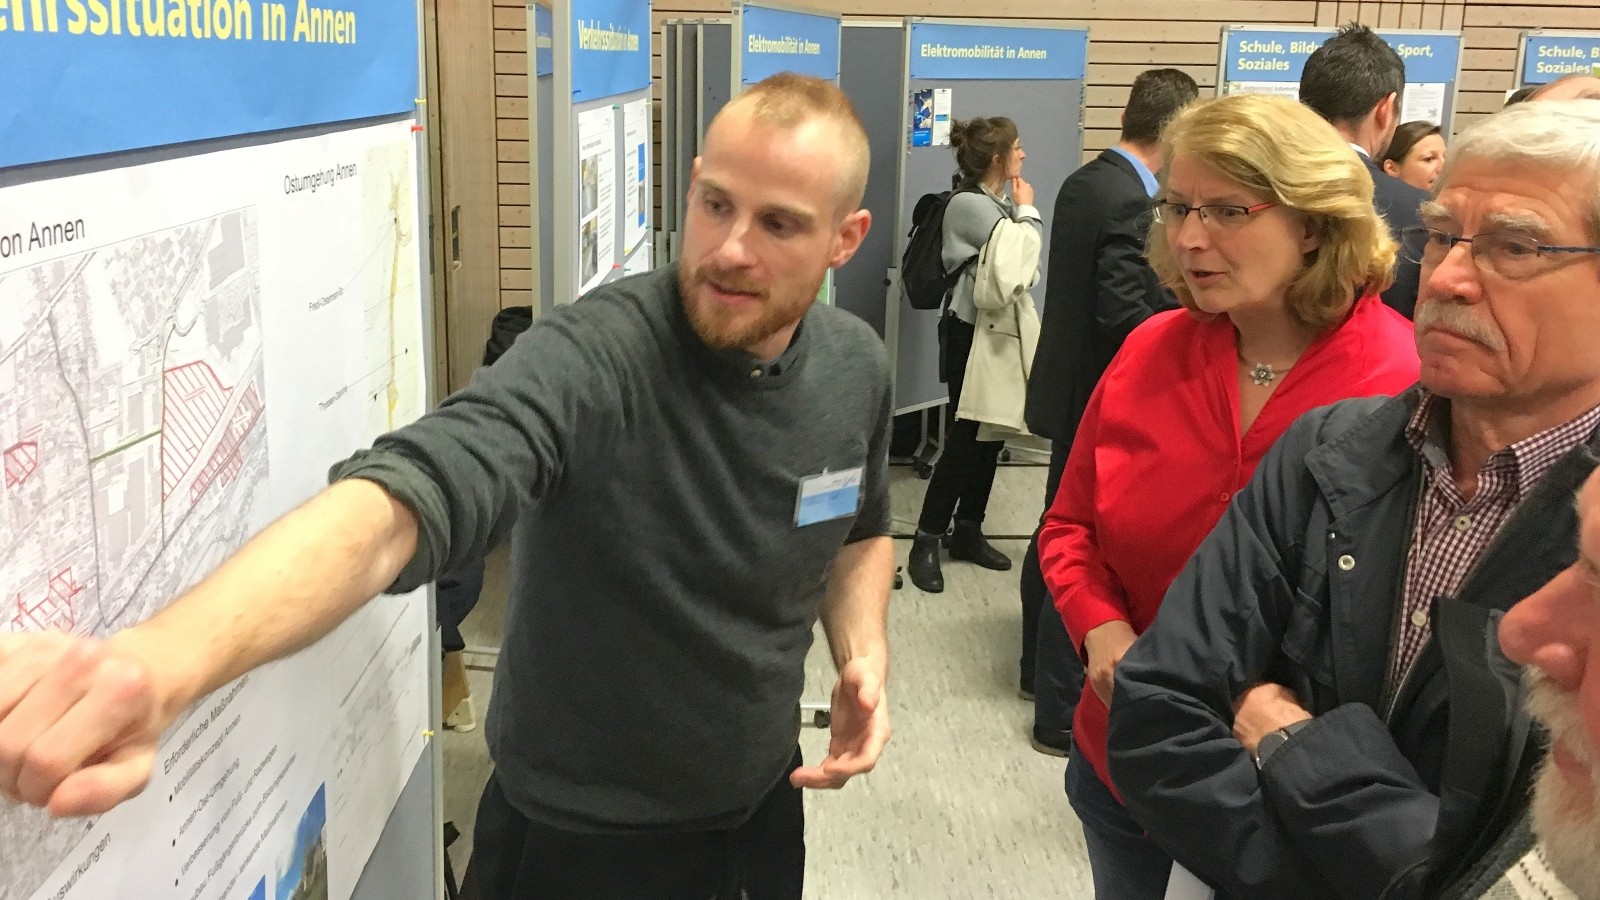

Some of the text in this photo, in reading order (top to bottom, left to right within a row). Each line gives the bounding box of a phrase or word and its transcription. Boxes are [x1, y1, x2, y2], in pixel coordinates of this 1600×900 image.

[262, 0, 286, 41] in
[293, 0, 356, 44] Annen
[748, 33, 820, 55] Elektromobilität in Annen
[921, 44, 1047, 59] Elektromobilität in Annen
[1239, 41, 1285, 55] Schule,
[1397, 44, 1434, 58] Sport,
[1538, 45, 1586, 59] Schule,
[1237, 58, 1290, 71] Soziales
[1536, 61, 1591, 74] Soziales
[284, 163, 358, 195] Ostumgehung Annen
[28, 218, 86, 251] Annen
[163, 674, 250, 775] Erforderliche Maßnahmen
